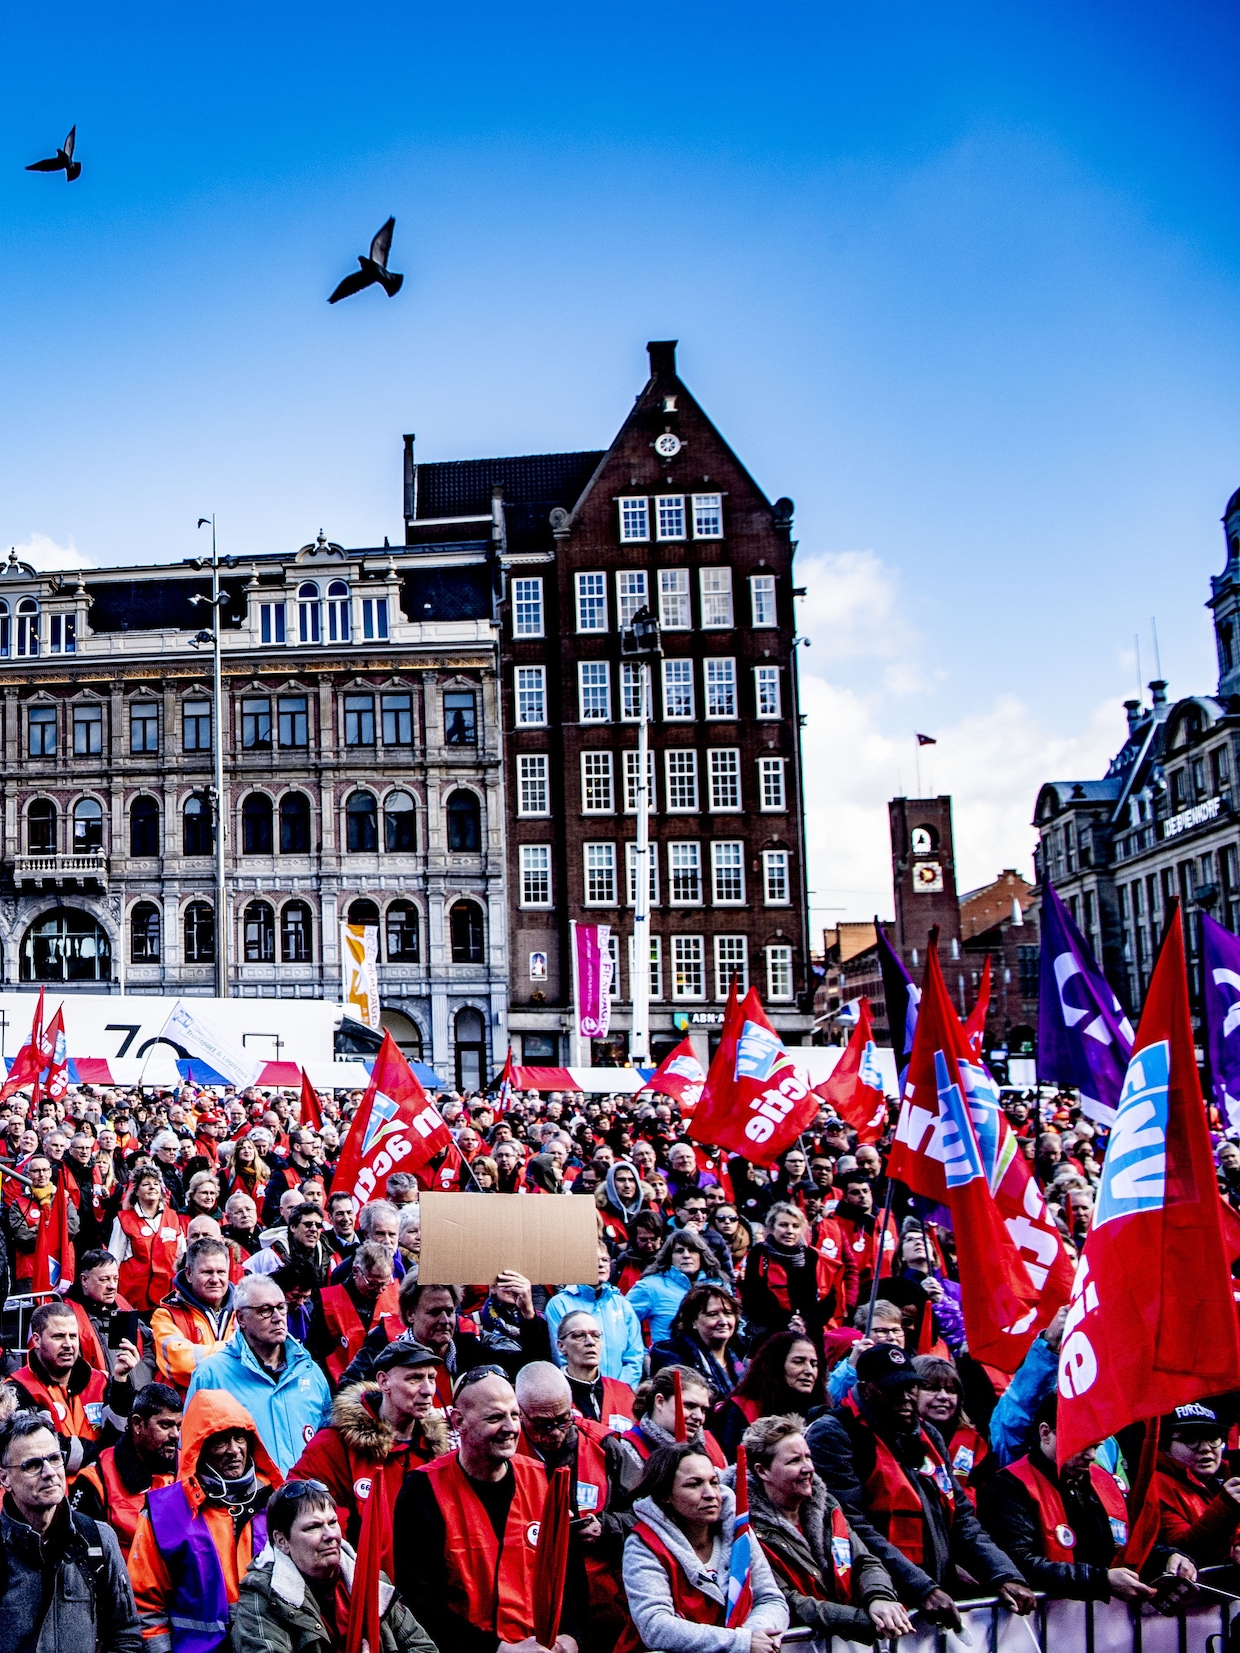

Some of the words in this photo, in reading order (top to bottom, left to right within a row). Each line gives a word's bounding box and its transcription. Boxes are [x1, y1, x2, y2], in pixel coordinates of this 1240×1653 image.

[186, 1029, 217, 1053] Transport
[222, 1055, 249, 1079] Logistiek
[1109, 1060, 1166, 1200] FNV
[361, 1483, 371, 1493] 66
